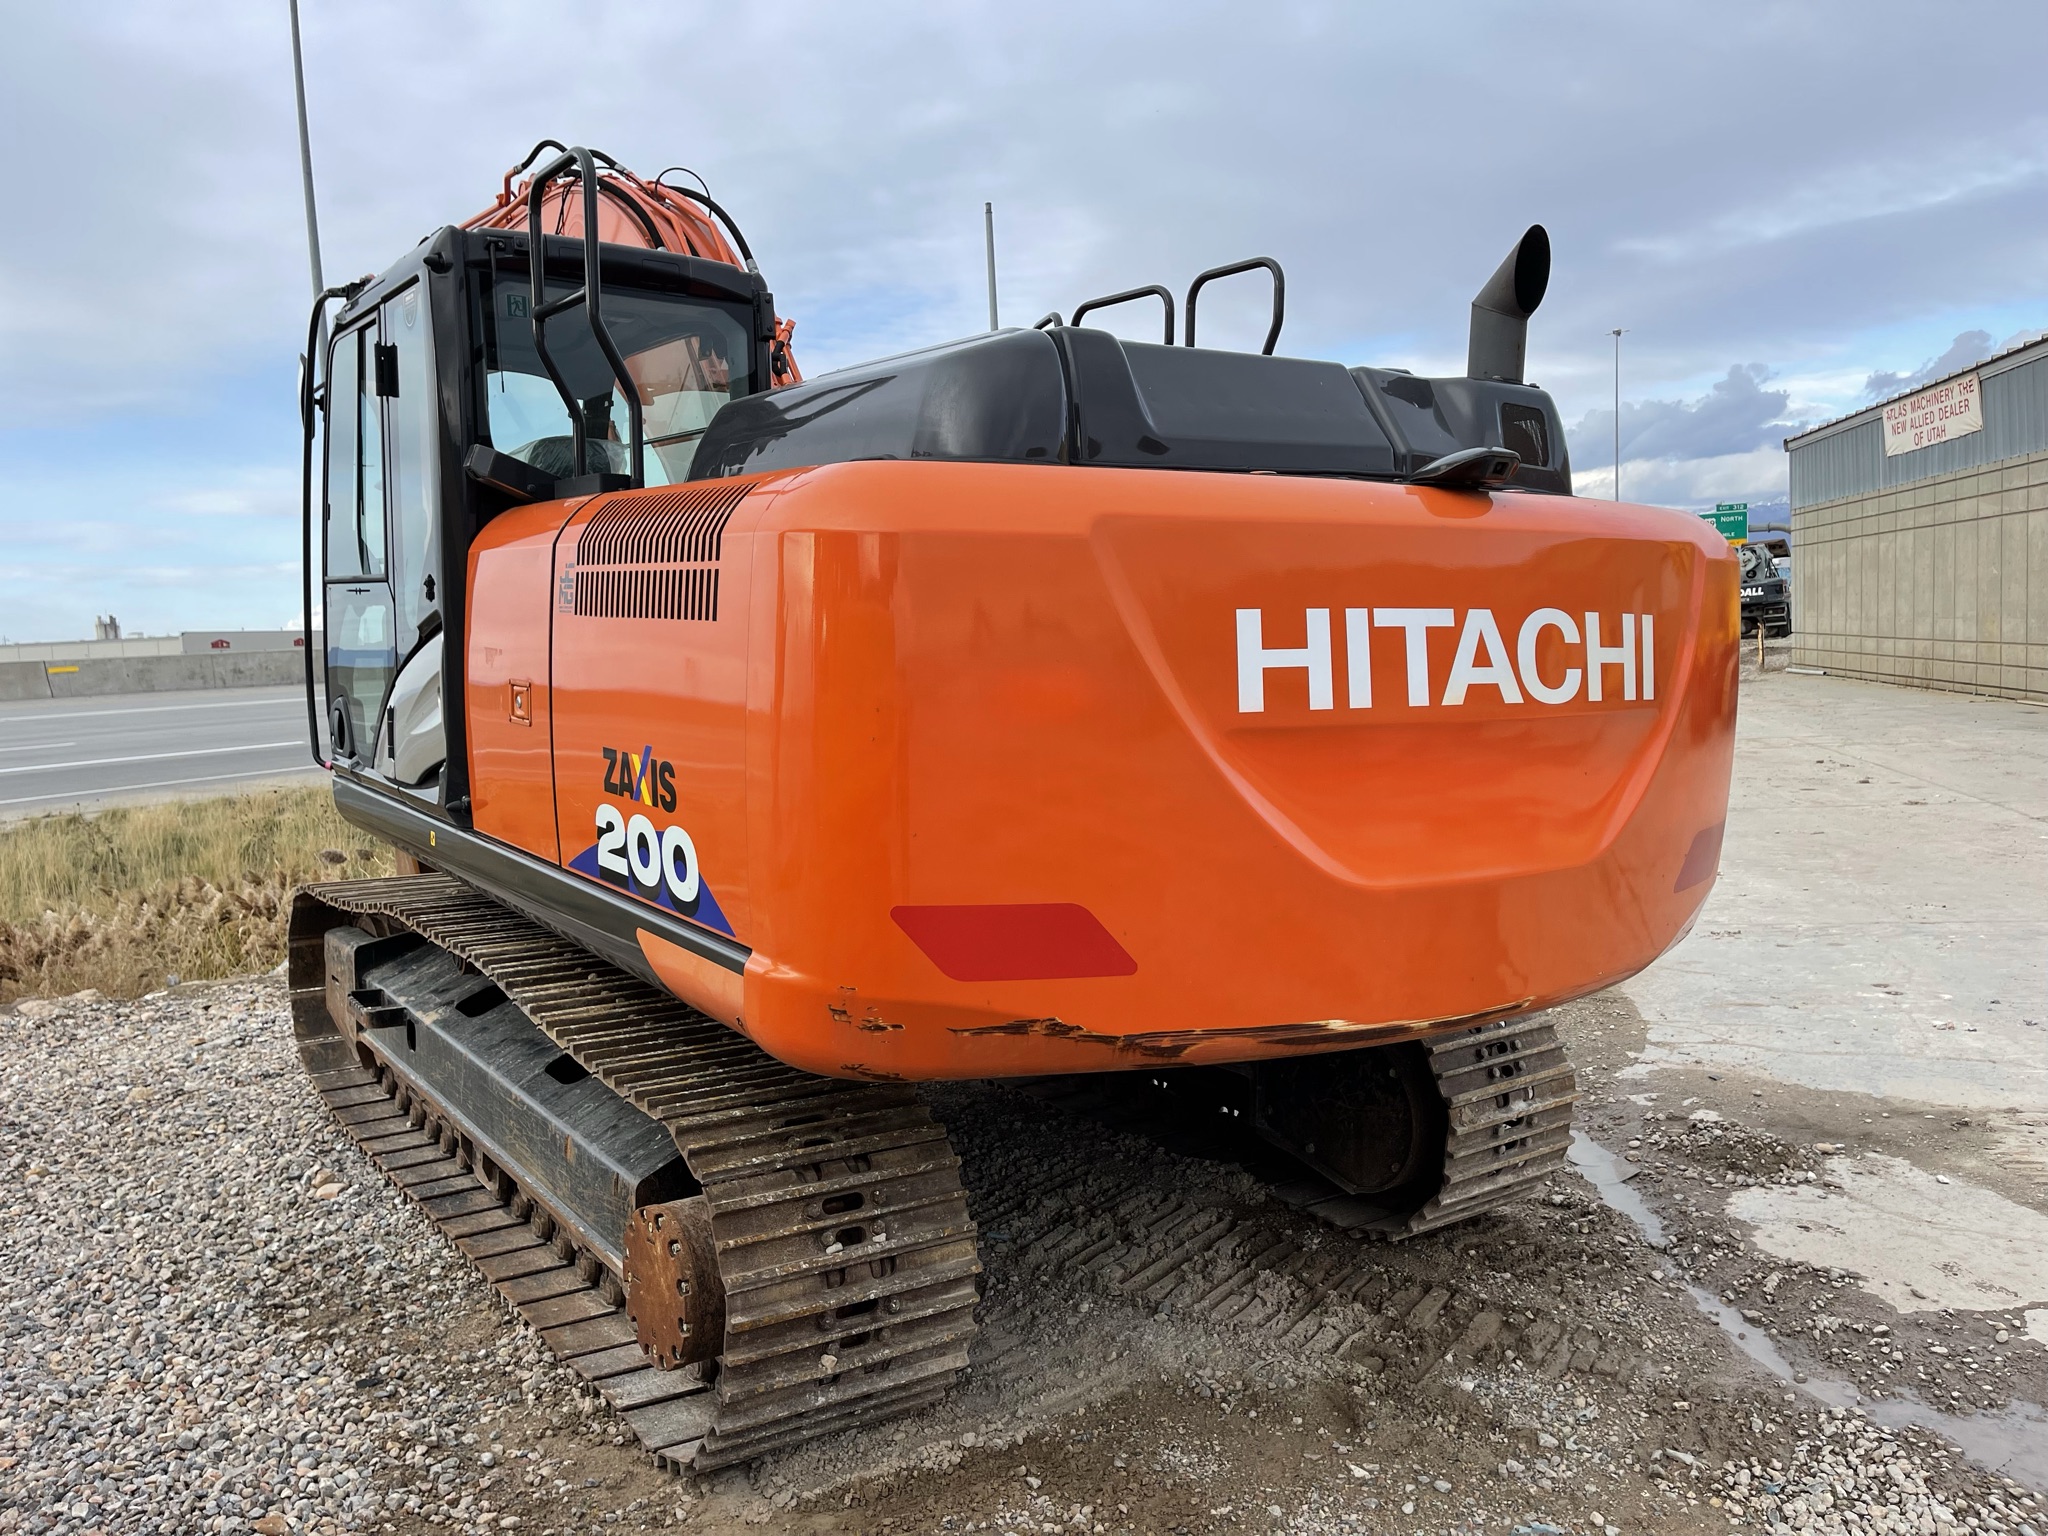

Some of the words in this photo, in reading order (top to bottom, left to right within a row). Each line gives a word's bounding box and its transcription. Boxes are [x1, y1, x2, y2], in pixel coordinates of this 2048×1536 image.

[1886, 404, 1908, 422] ATLAS
[1910, 385, 1955, 413] MACHINERY
[1957, 379, 1975, 396] THE
[1891, 421, 1907, 436] NEW
[1910, 411, 1935, 431] ALLIED
[1938, 398, 1970, 421] DEALER
[1913, 431, 1924, 446] OF
[1926, 424, 1947, 442] UTAH
[1235, 607, 1655, 713] HITACHI
[602, 745, 678, 814] ZAXIS
[595, 803, 700, 904] 200
